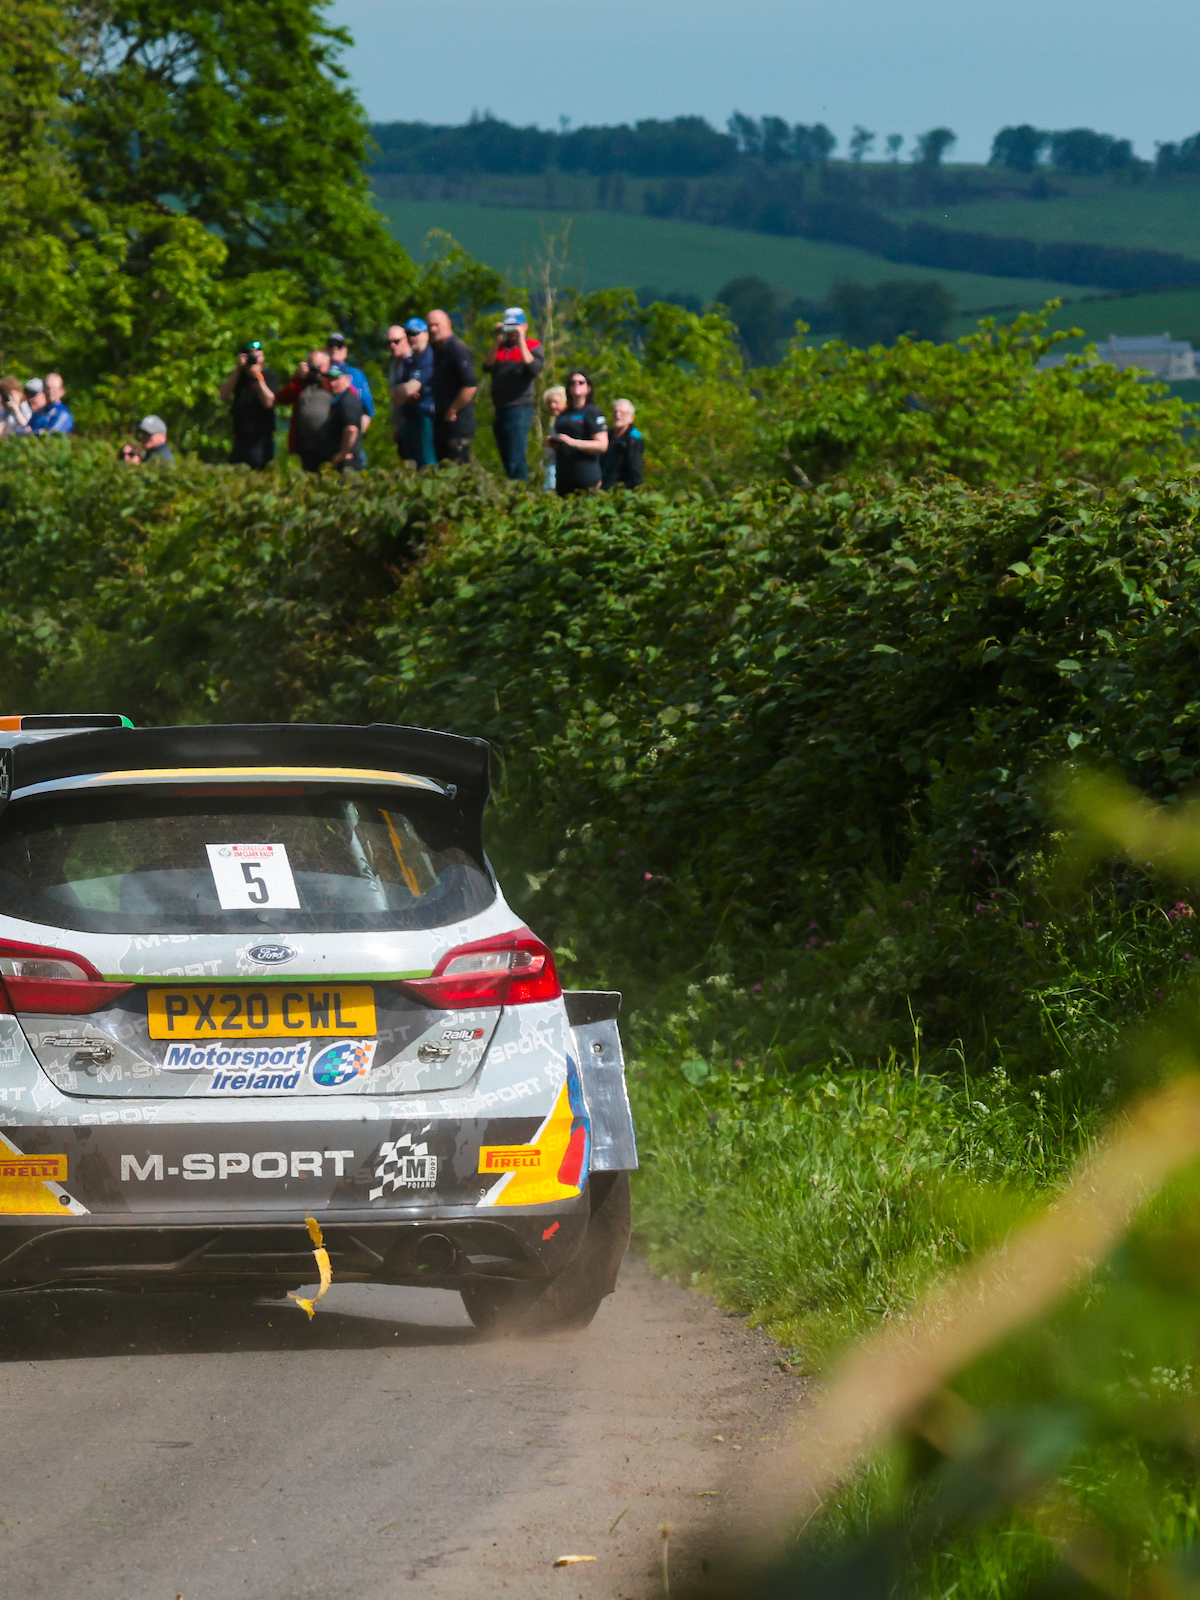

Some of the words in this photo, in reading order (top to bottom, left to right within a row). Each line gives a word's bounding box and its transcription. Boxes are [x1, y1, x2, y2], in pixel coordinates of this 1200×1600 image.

[240, 862, 269, 904] 5
[257, 947, 285, 960] Ford
[165, 992, 270, 1031] PX20
[282, 992, 357, 1029] CWL
[41, 1036, 106, 1047] Fiesta
[441, 1028, 484, 1041] Rally2
[167, 1046, 307, 1069] Motorsport
[211, 1070, 302, 1090] Ireland
[120, 1150, 355, 1181] M-SPORT
[406, 1158, 425, 1178] M
[486, 1149, 541, 1168] PIRELLI
